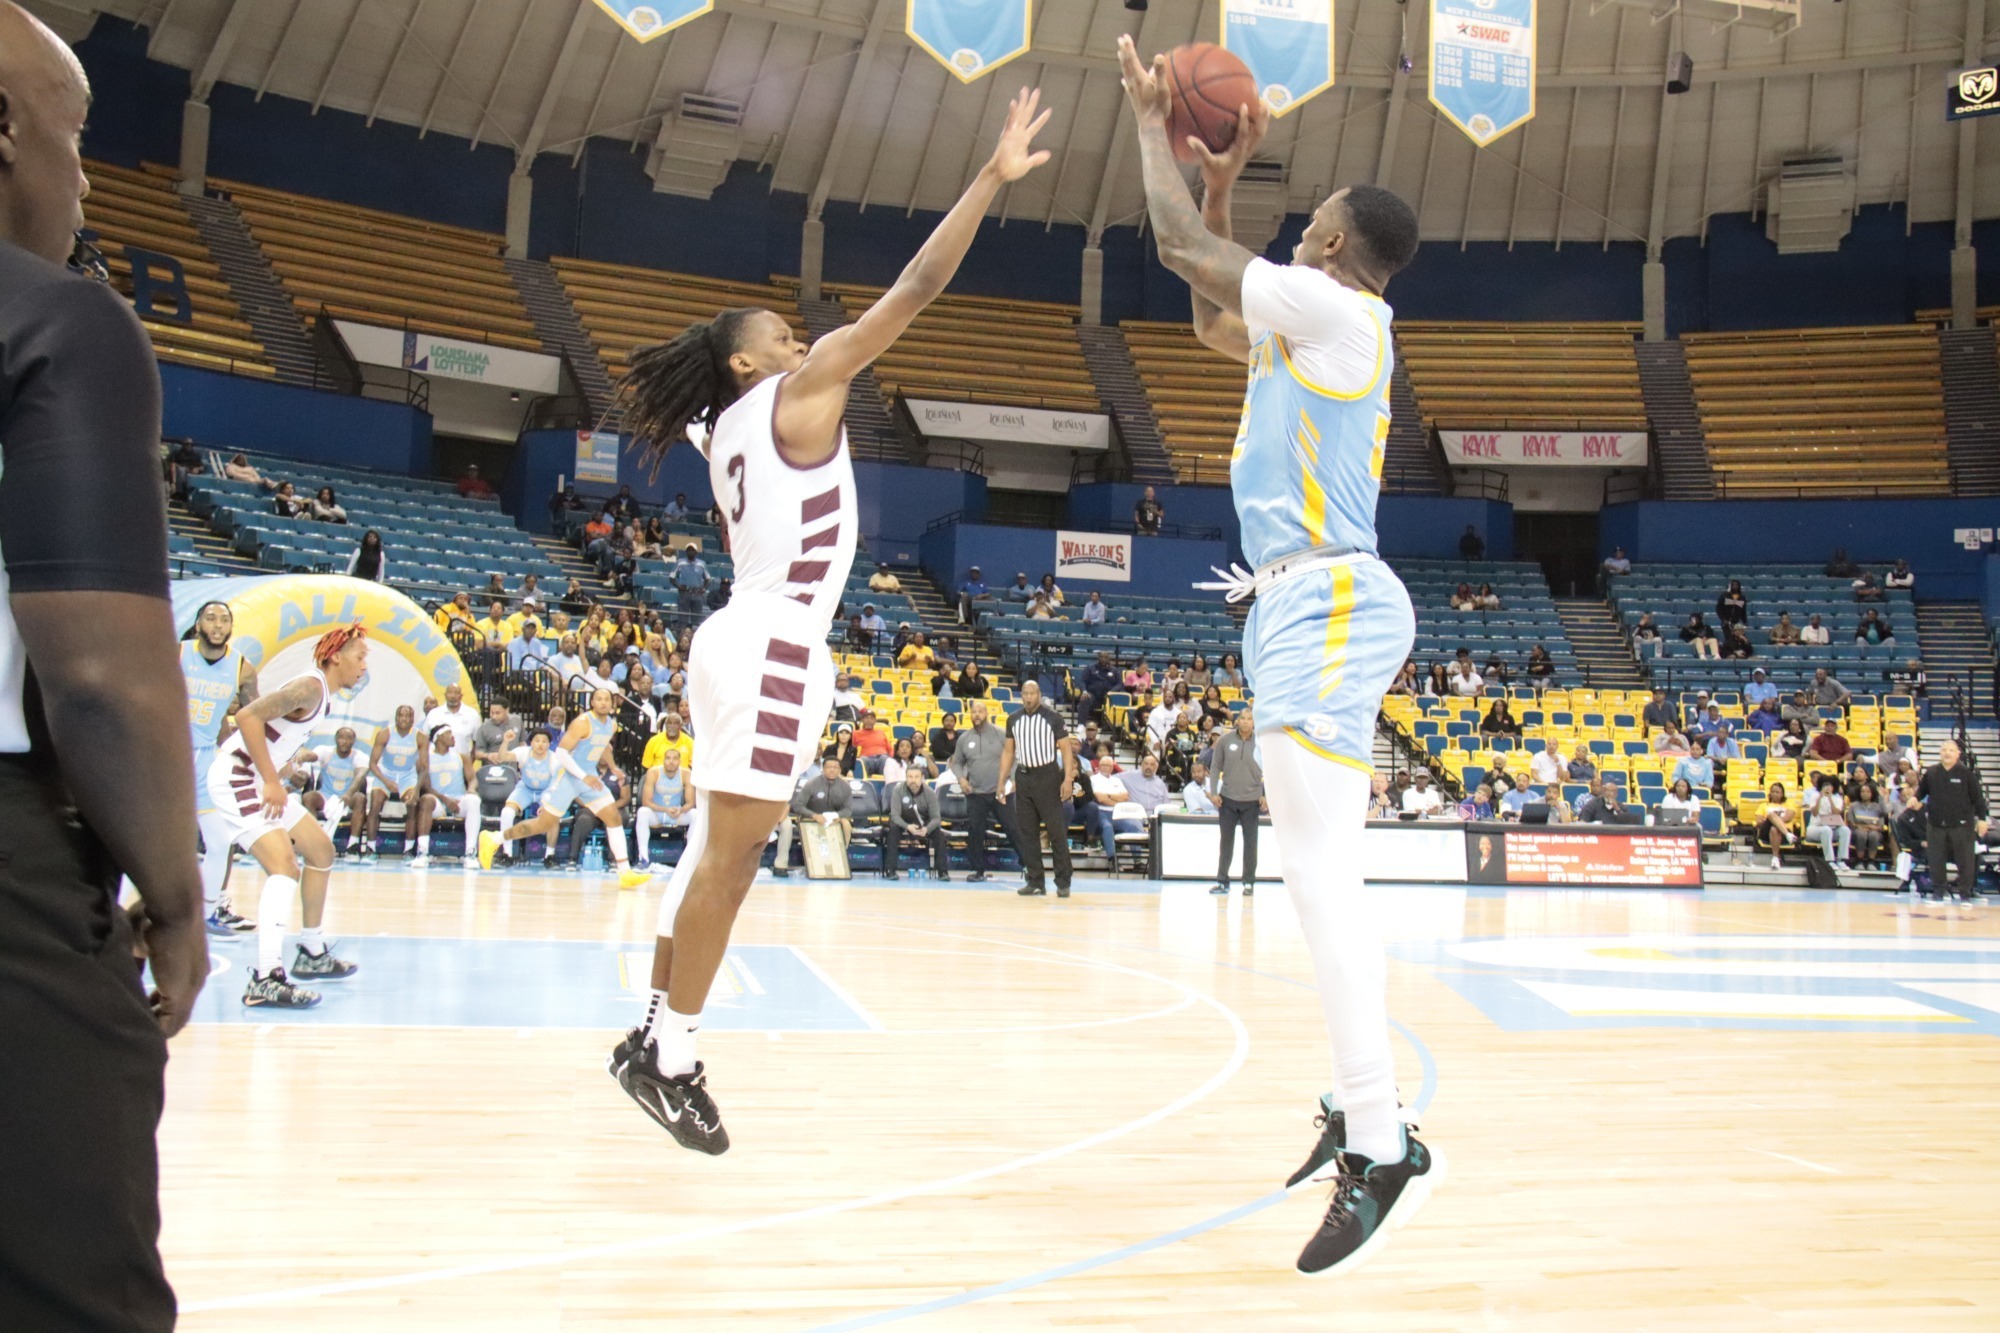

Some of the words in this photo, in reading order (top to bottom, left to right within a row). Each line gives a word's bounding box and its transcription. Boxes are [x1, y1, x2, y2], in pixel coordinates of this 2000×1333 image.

[1470, 25, 1511, 43] SWAC
[1955, 101, 2000, 114] DODGE
[123, 244, 193, 323] B
[430, 344, 490, 365] LOUISIANA
[434, 358, 485, 376] LOTTERY
[726, 454, 746, 524] 3
[277, 594, 364, 642] ALL
[376, 606, 443, 655] IN
[1047, 646, 1066, 654] M-7
[1506, 834, 1518, 842] The
